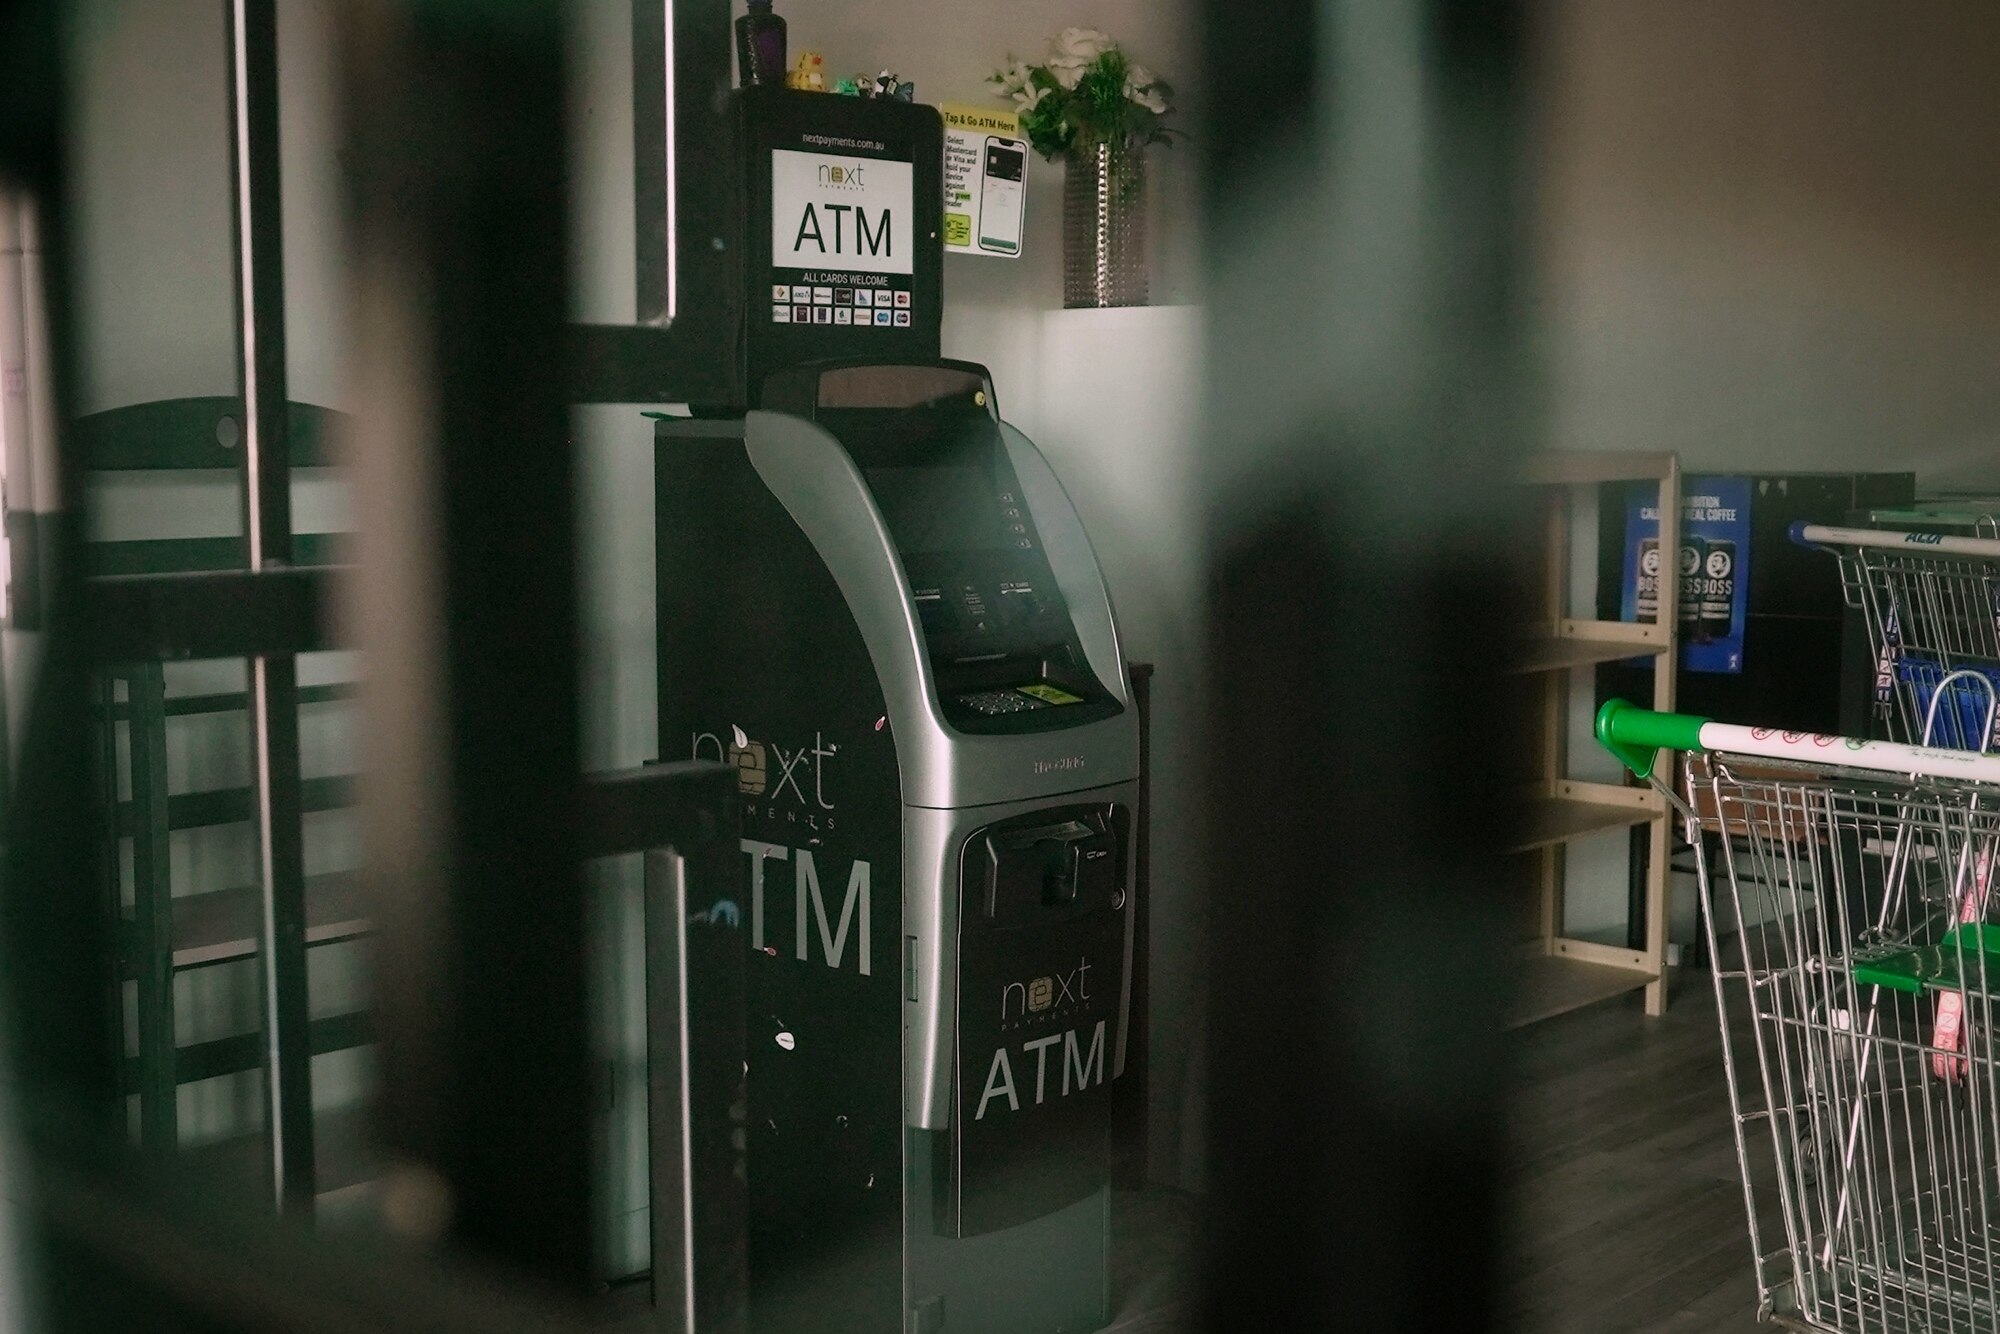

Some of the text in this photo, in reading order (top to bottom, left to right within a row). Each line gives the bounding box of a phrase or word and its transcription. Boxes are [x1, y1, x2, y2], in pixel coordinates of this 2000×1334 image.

[945, 112, 1015, 131] Tap & Go ATM Here
[802, 133, 885, 150] nextpayments.com.au
[818, 163, 865, 186] next
[793, 202, 891, 257] ATM
[802, 272, 889, 286] ALL CARDS WELCOME
[877, 294, 891, 302] VISA
[1706, 508, 1737, 521] COFFEE
[1638, 576, 1659, 592] BOS
[1702, 579, 1733, 595] BOSS
[747, 805, 835, 830] MENTS
[740, 838, 870, 977] TM
[1002, 956, 1092, 1020] next
[1001, 1001, 1090, 1032] PAYMENTS
[975, 1020, 1106, 1121] ATM
